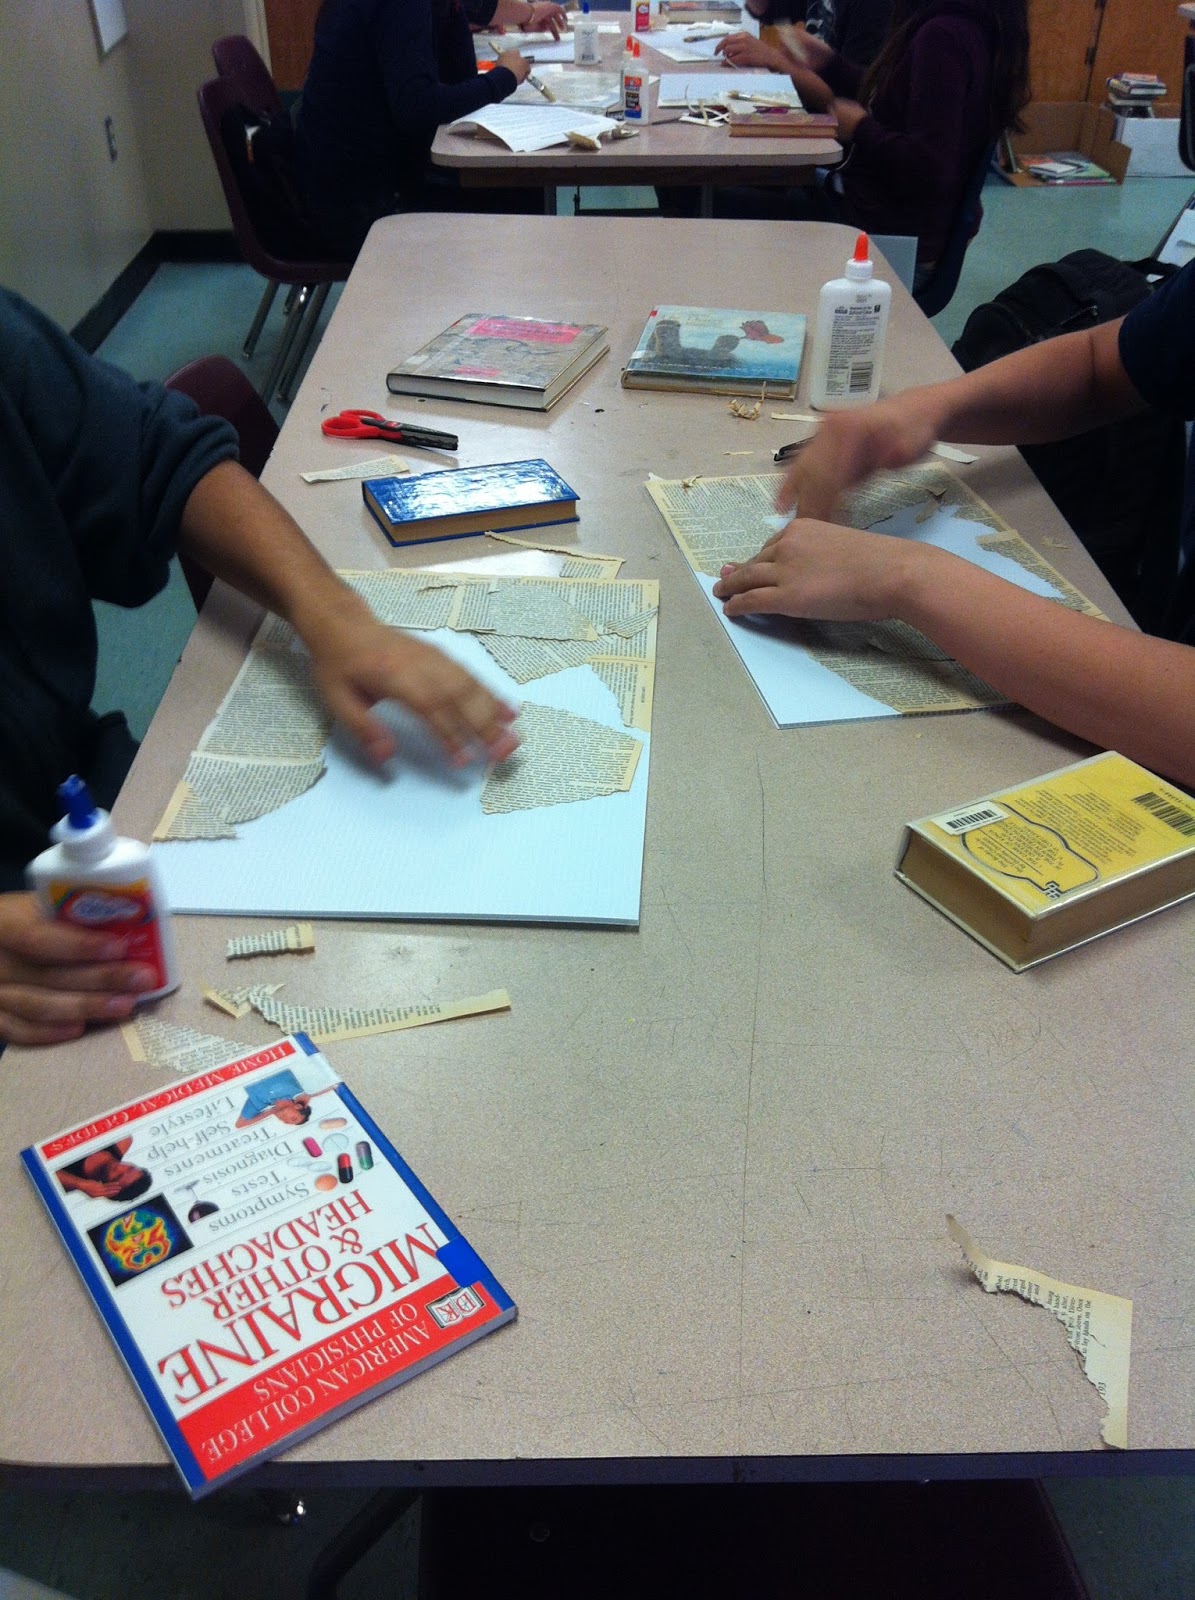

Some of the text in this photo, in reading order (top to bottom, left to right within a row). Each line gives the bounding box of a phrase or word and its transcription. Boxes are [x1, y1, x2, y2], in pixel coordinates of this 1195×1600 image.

[229, 1046, 287, 1074] HOME
[51, 1111, 129, 1151] GUIDES
[148, 1120, 231, 1161] Self-help
[150, 1096, 235, 1138] Lifestyle
[164, 1127, 277, 1177] Treatments
[203, 1141, 294, 1185] Diagnosis
[209, 1182, 310, 1232] Symptoms
[231, 1170, 287, 1197] Tests
[160, 1189, 373, 1308] HEADACHES
[201, 1227, 363, 1322] & OTHER
[157, 1222, 440, 1406] MIGRAINE
[436, 1292, 477, 1322] DK
[253, 1303, 418, 1402] OF PHYSICIANS
[202, 1320, 431, 1463] AMERICAN COLLEGE
